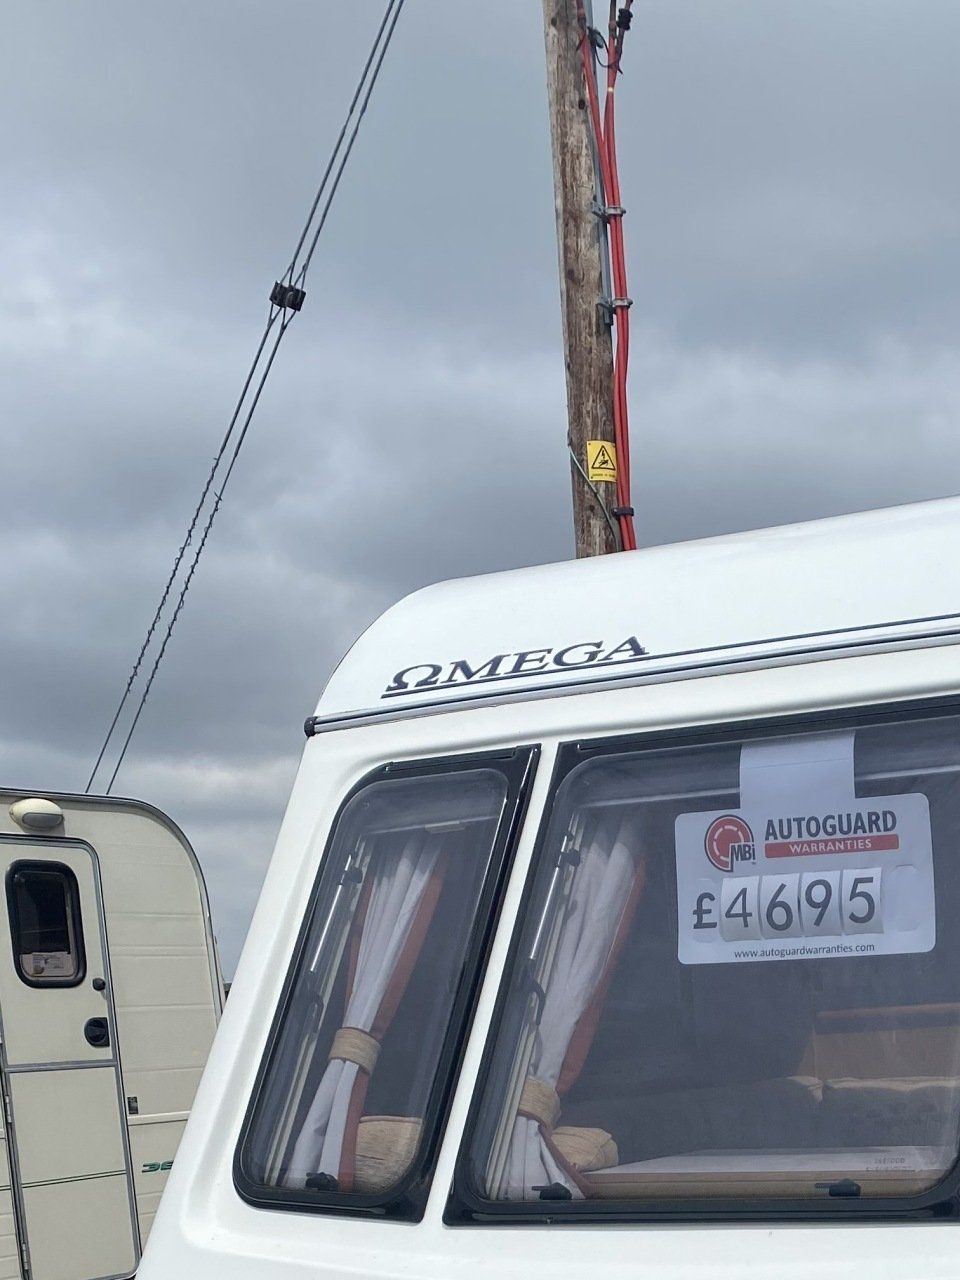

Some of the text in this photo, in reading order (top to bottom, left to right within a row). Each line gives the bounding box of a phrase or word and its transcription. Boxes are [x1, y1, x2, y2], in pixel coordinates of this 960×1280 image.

[764, 810, 897, 841] AUTOGUARD
[789, 838, 872, 854] WARRANTIES
[692, 877, 876, 932] £4695
[734, 943, 875, 958] www.autoguardwarranties.com
